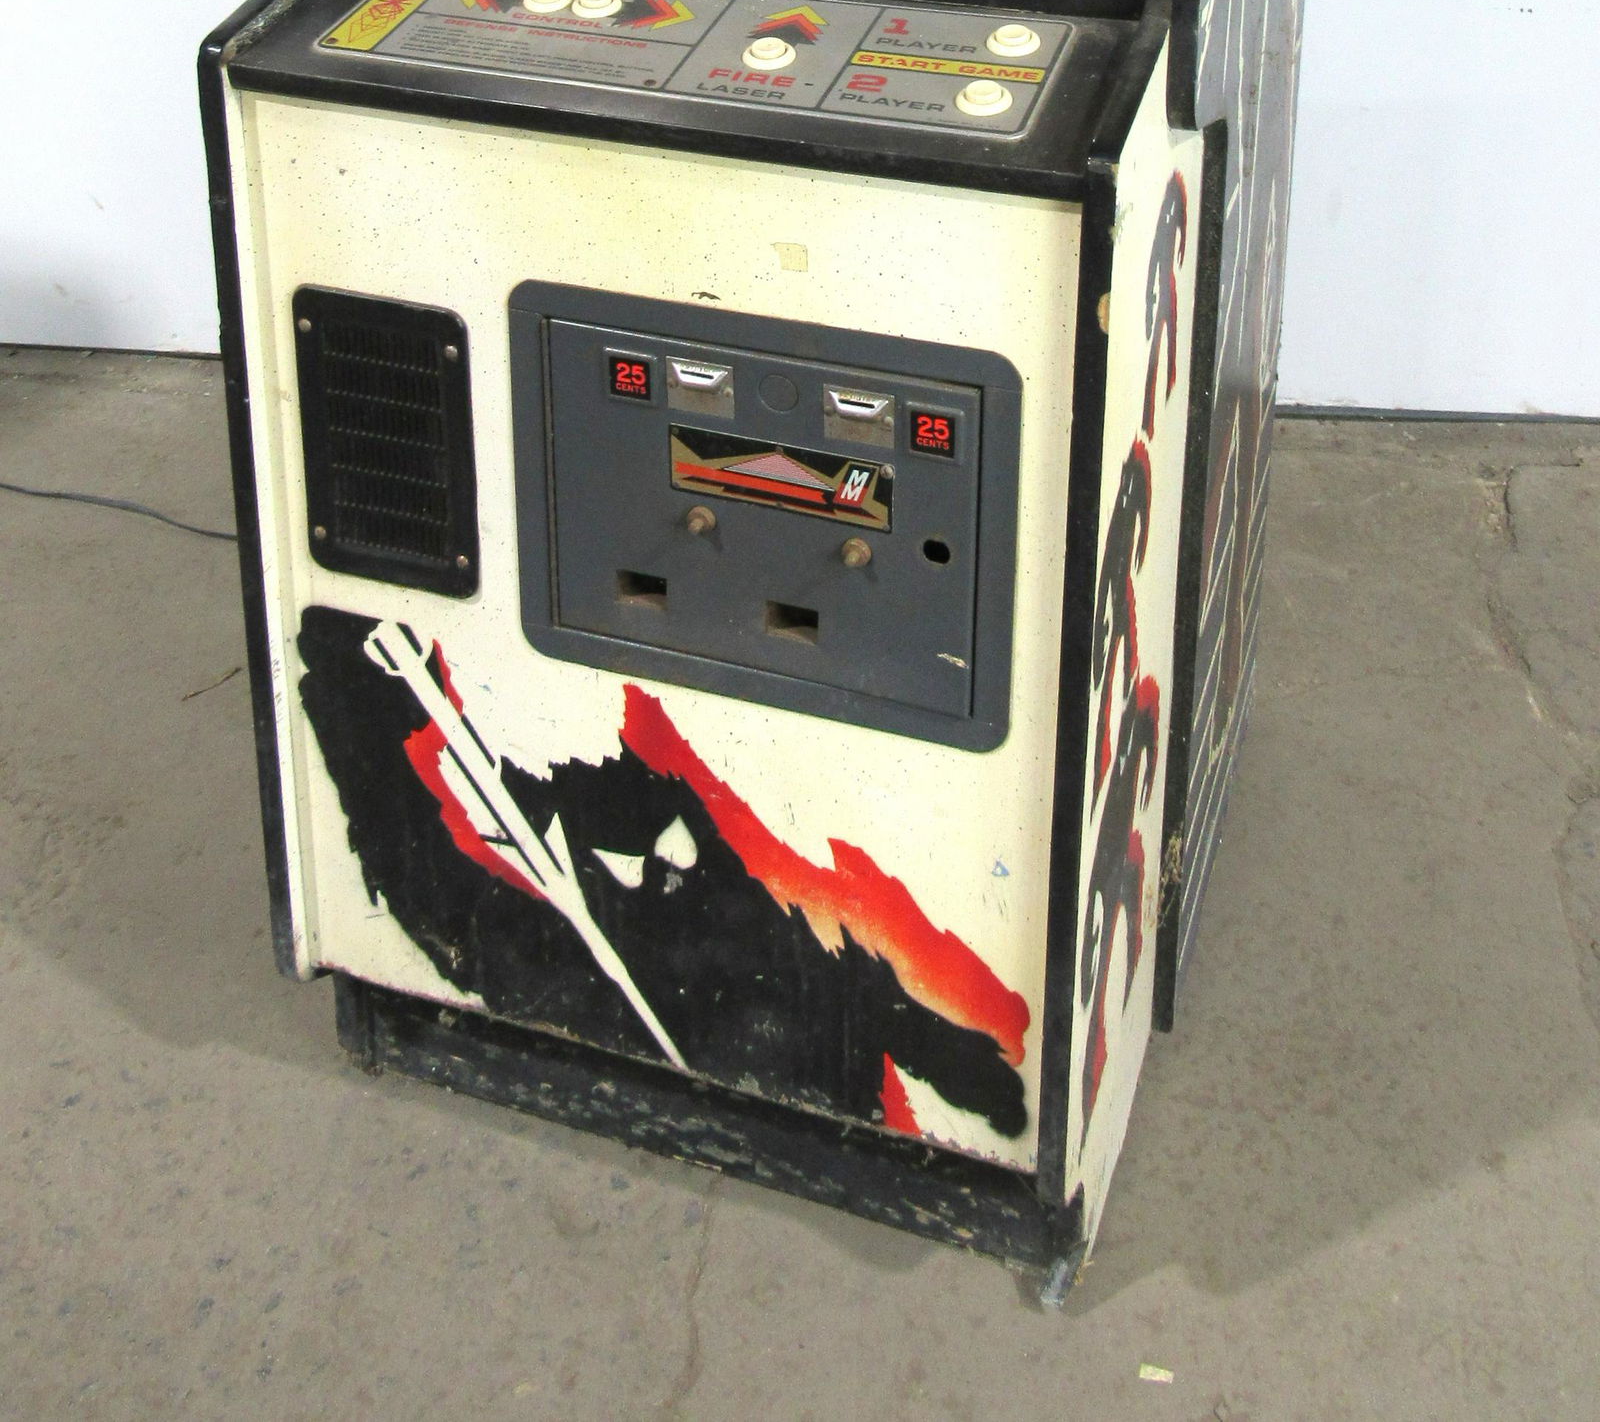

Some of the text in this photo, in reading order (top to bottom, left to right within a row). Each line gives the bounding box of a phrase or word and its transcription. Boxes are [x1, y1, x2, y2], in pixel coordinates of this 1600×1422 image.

[511, 12, 604, 29] CONTROL
[882, 17, 911, 36] 1
[443, 18, 518, 33] DEFENSE
[526, 28, 649, 50] INSTRUCTIONS
[876, 36, 978, 55] PLAYER
[707, 67, 797, 88] FIRE
[857, 53, 1040, 81] START GAME
[696, 81, 787, 100] LASER
[846, 72, 889, 93] 2
[838, 92, 946, 113] PLAYER
[615, 361, 647, 386] 25
[615, 381, 648, 395] CENTS
[916, 414, 950, 441] 25
[916, 437, 951, 451] CENTS
